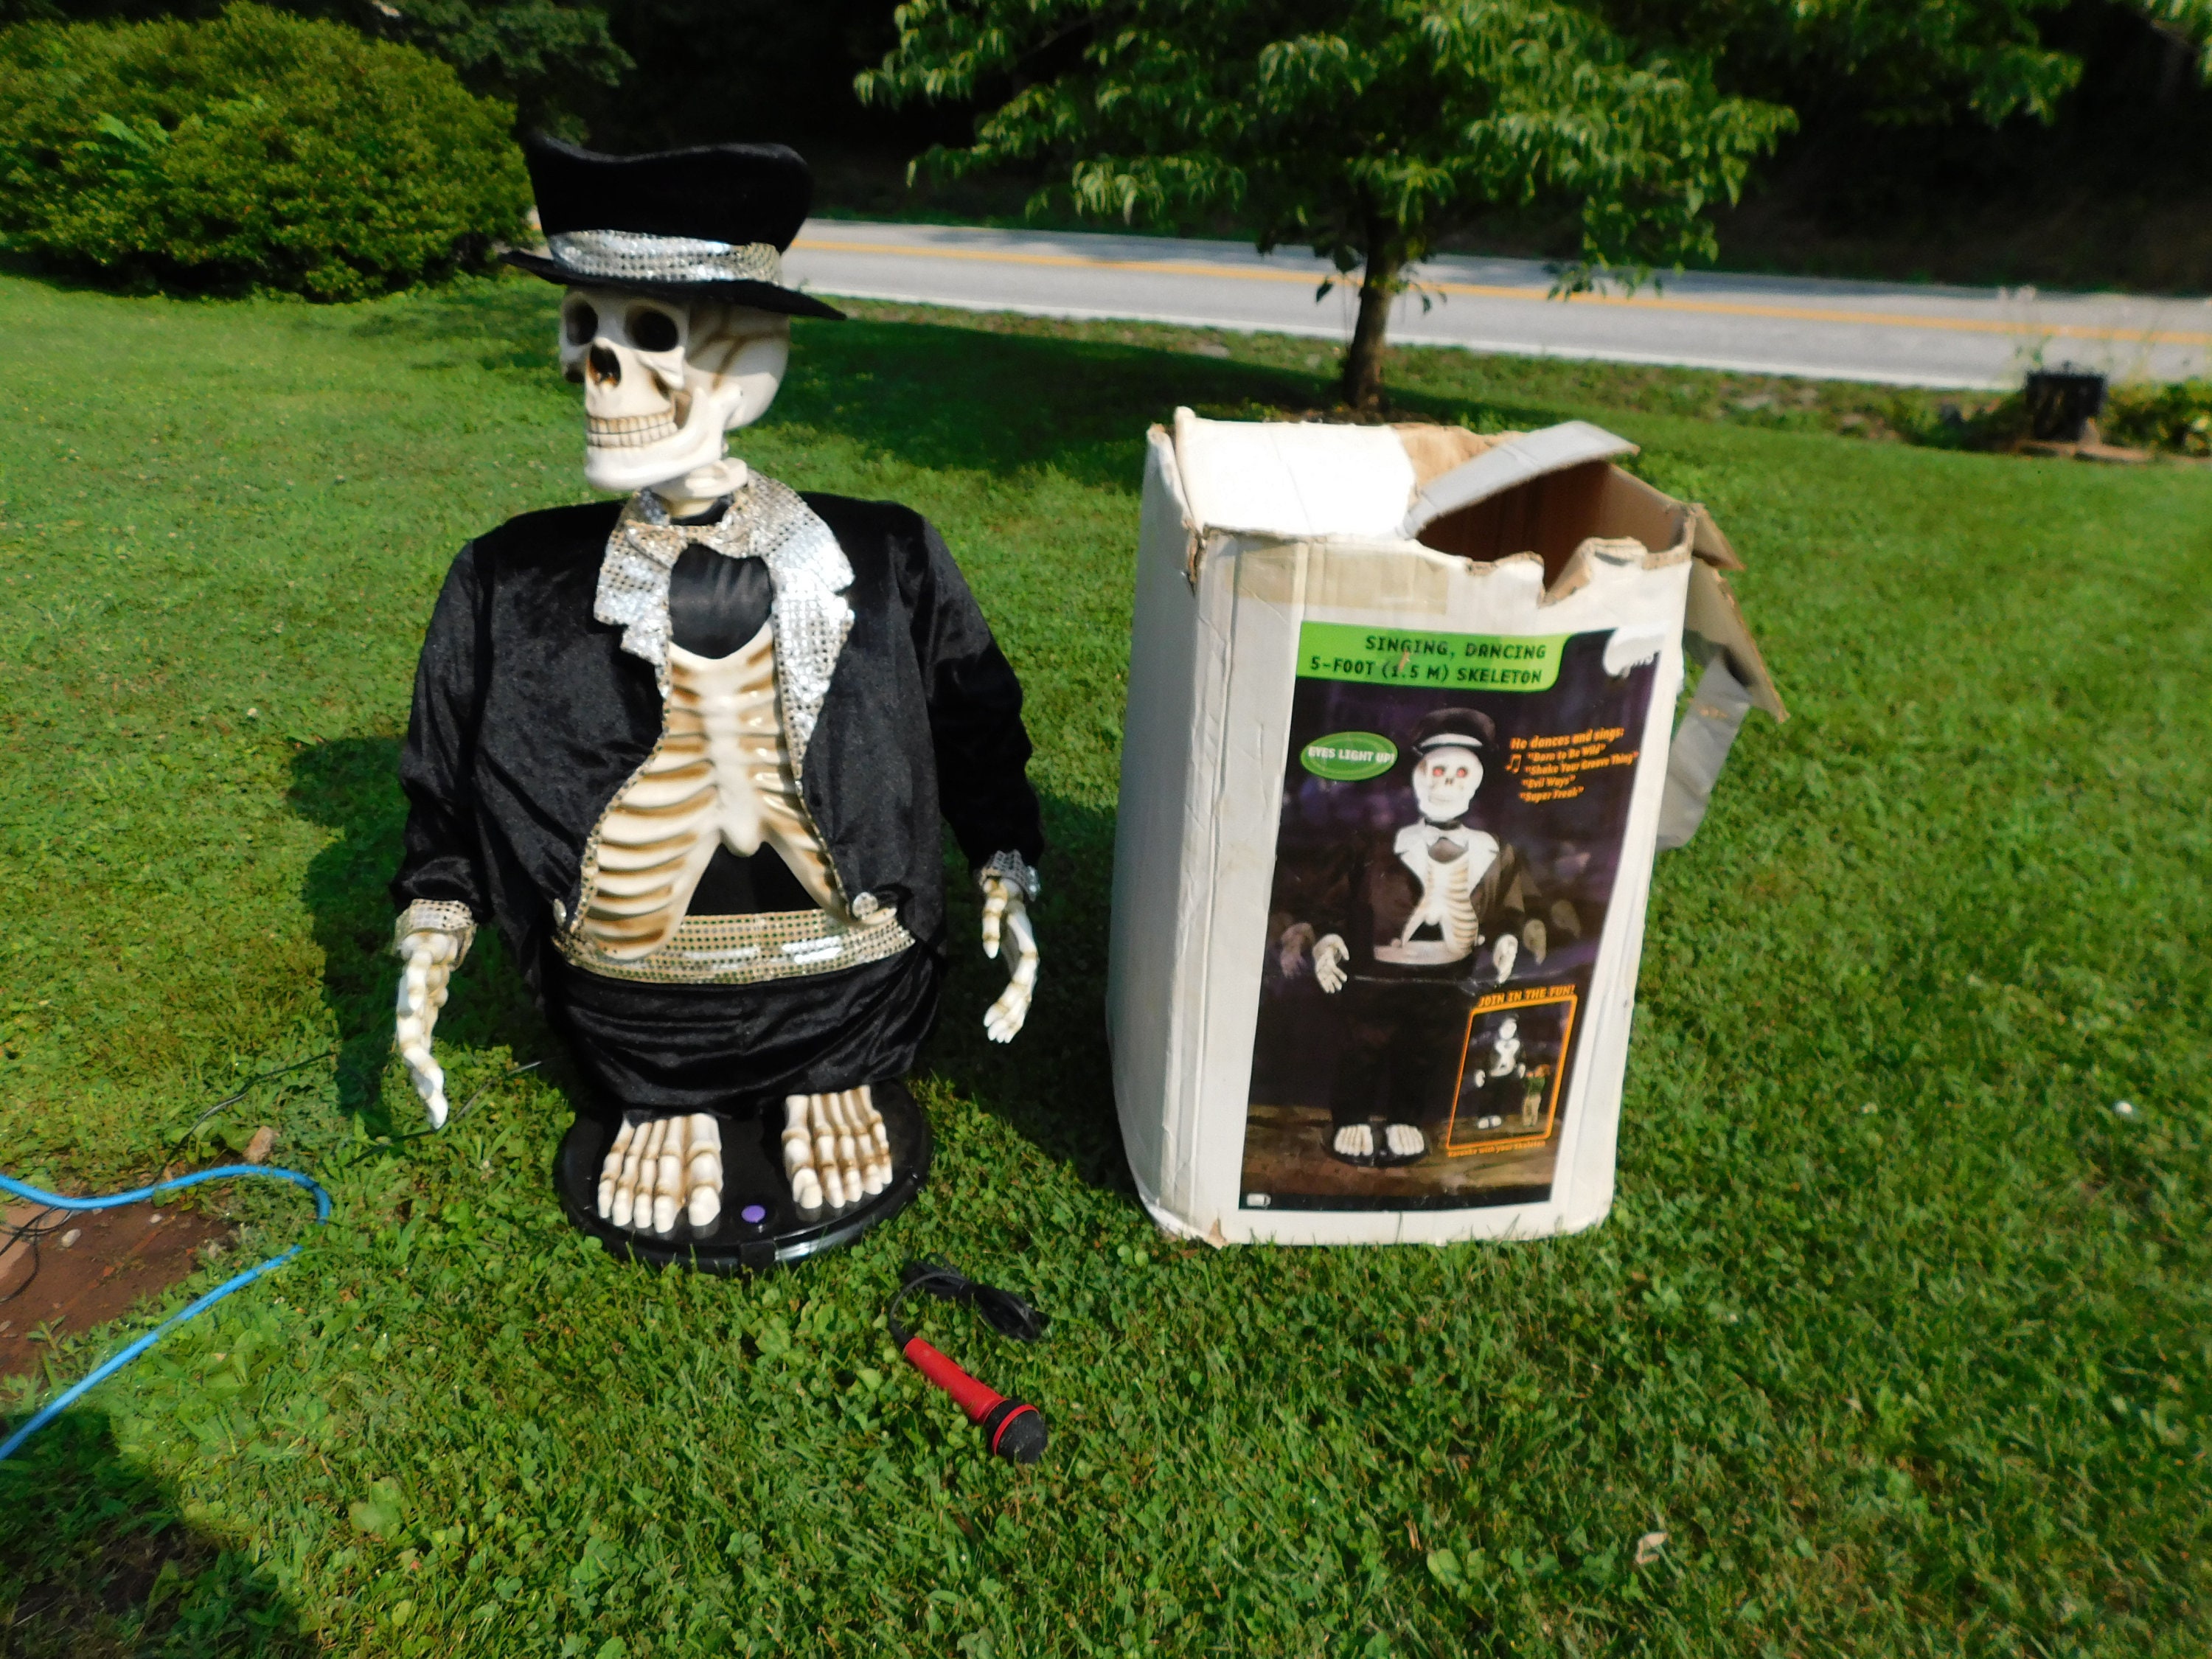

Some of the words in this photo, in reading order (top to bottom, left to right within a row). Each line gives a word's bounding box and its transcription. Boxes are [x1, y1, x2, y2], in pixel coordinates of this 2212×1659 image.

[1366, 635, 1455, 659] SINGING,
[1465, 642, 1546, 659] DANCING
[1310, 655, 1376, 675] 5-FOOT
[1381, 661, 1420, 679] (1.5
[1427, 664, 1450, 682] M)
[1457, 667, 1543, 684] SKELETON
[1530, 735, 1571, 749] dances
[1571, 728, 1593, 744] and
[1593, 727, 1625, 742] sings:
[1308, 746, 1335, 759] EYES
[1338, 749, 1374, 762] LIGHT
[1375, 752, 1395, 763] UP!
[1557, 751, 1568, 760] to
[1568, 748, 1581, 759] Be
[1560, 762, 1581, 773] Your
[1478, 992, 1505, 1007] JOIN
[1507, 990, 1523, 1003] IN
[1525, 987, 1547, 1000] THE
[1549, 984, 1575, 997] FUN!
